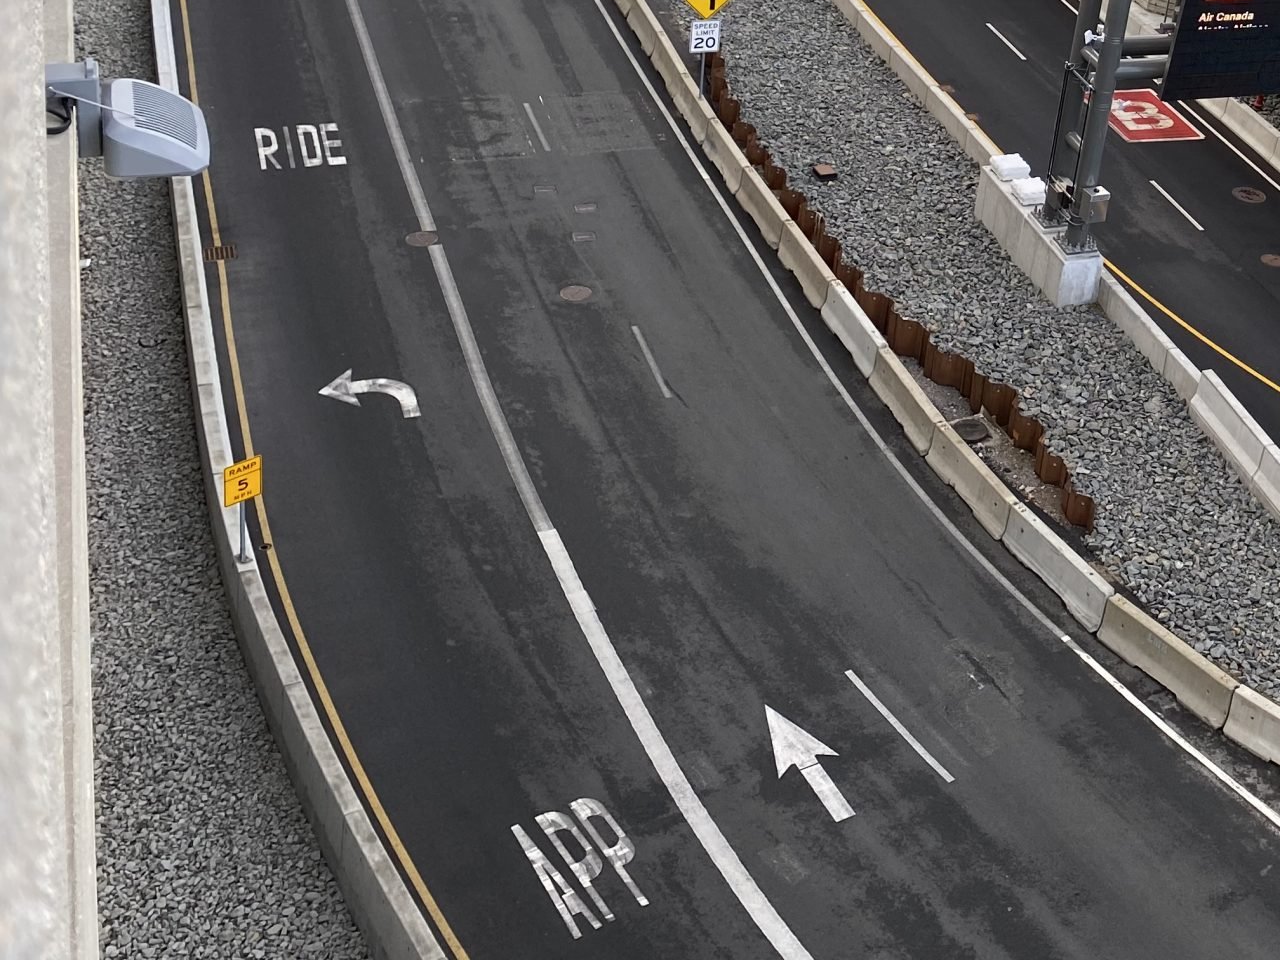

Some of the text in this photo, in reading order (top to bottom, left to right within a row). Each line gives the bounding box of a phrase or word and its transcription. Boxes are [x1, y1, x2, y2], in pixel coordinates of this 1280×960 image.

[1198, 11, 1254, 22] Air Canada
[693, 37, 716, 49] 20
[1111, 99, 1175, 131] B
[254, 122, 347, 170] RIDE
[229, 461, 257, 477] RAMP
[238, 478, 249, 491] 5
[510, 797, 650, 940] APP
